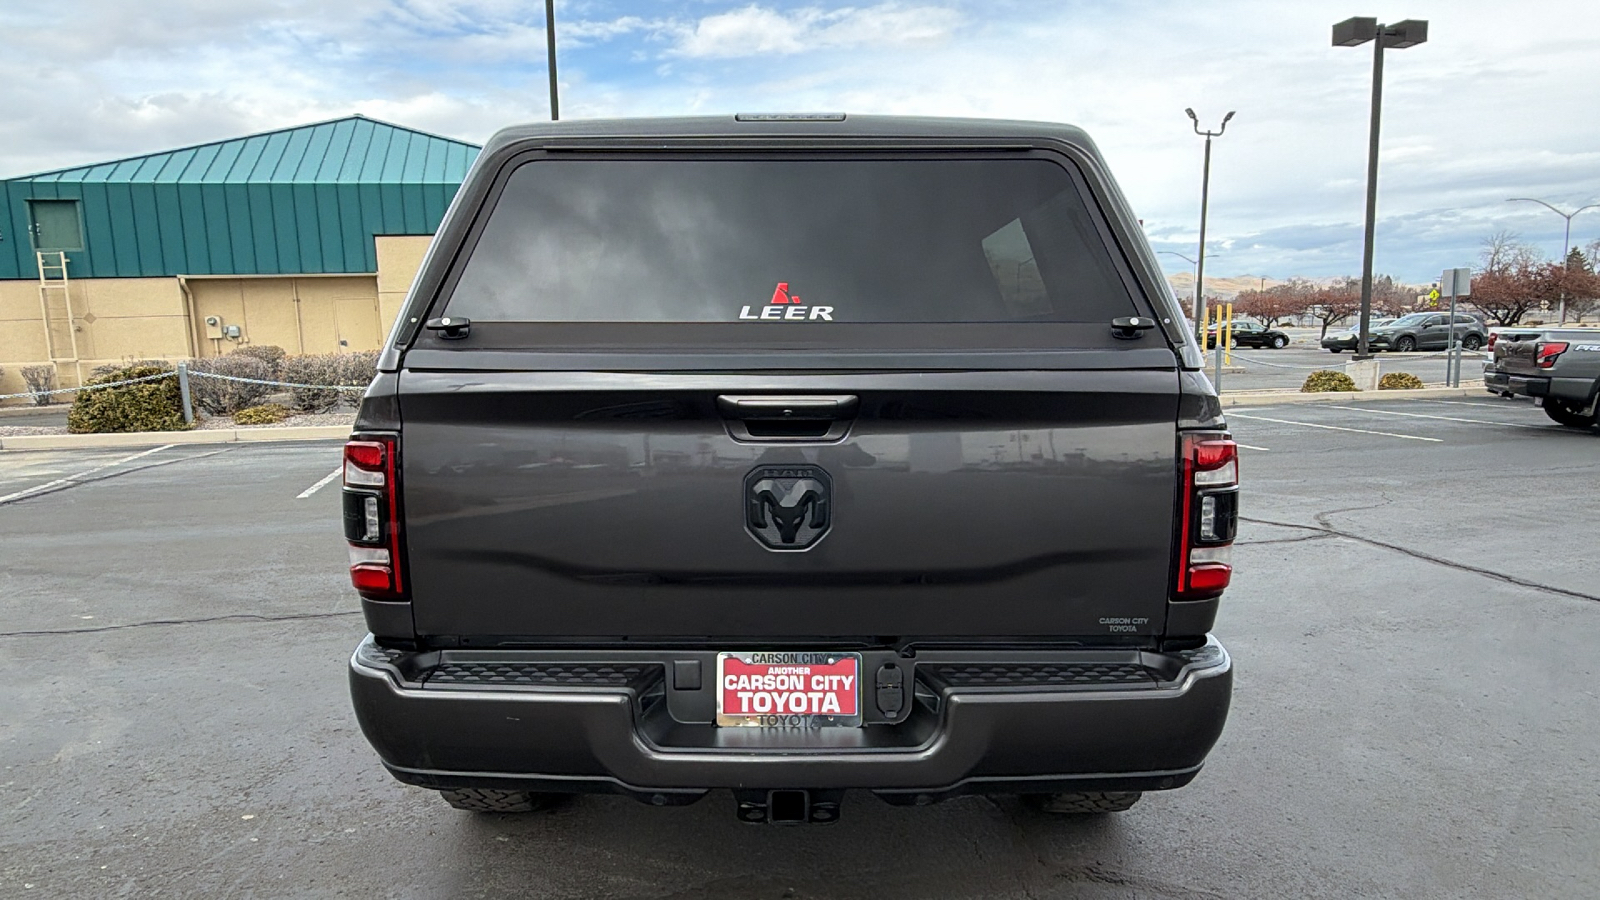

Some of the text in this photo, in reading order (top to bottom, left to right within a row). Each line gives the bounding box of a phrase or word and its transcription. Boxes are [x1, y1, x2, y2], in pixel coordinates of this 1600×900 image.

[739, 305, 834, 321] LEER
[752, 653, 828, 664] CARSON CITY
[768, 666, 810, 675] ANOTHER
[724, 675, 853, 690] CARSON CITY
[737, 692, 840, 713] TOYOTA
[758, 714, 820, 726] TOYOTA
